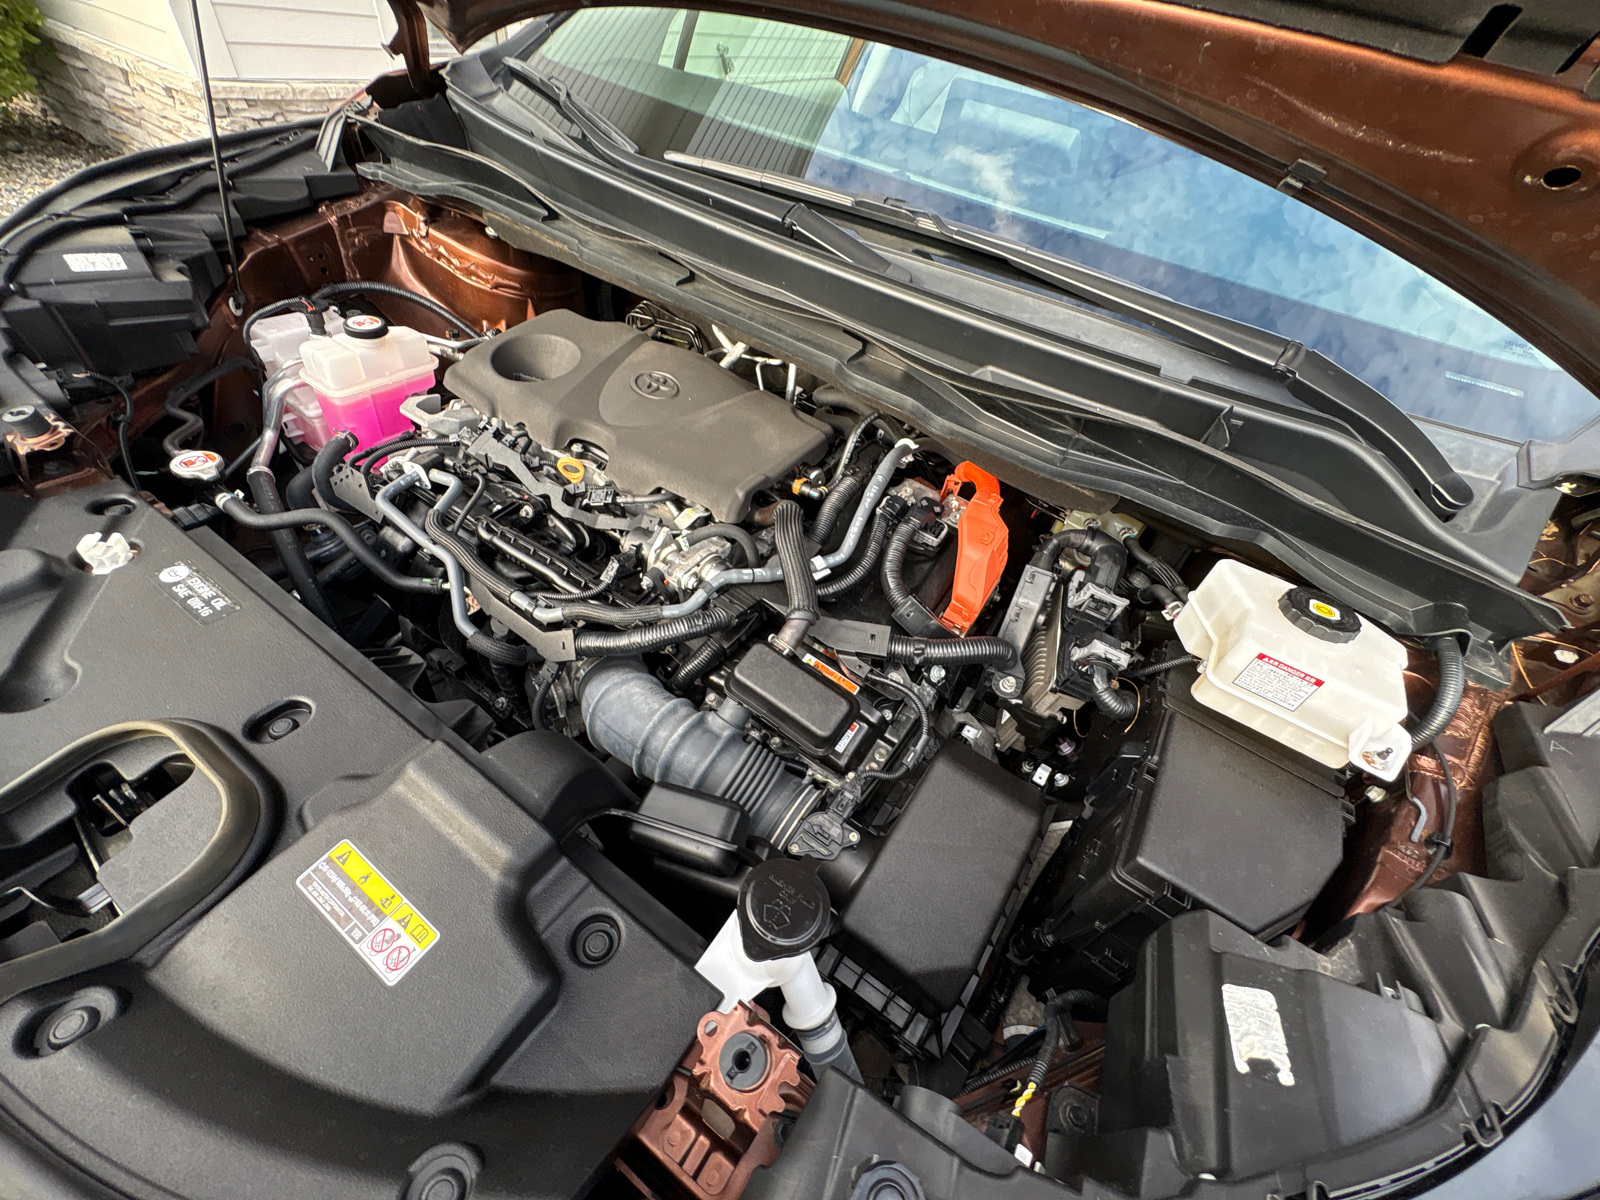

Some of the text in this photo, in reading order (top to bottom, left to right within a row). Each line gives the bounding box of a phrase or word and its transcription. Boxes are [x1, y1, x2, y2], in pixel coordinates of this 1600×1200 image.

[172, 583, 193, 599] SAE
[187, 577, 228, 611] ENGINE OIL
[1278, 663, 1305, 679] DANGER
